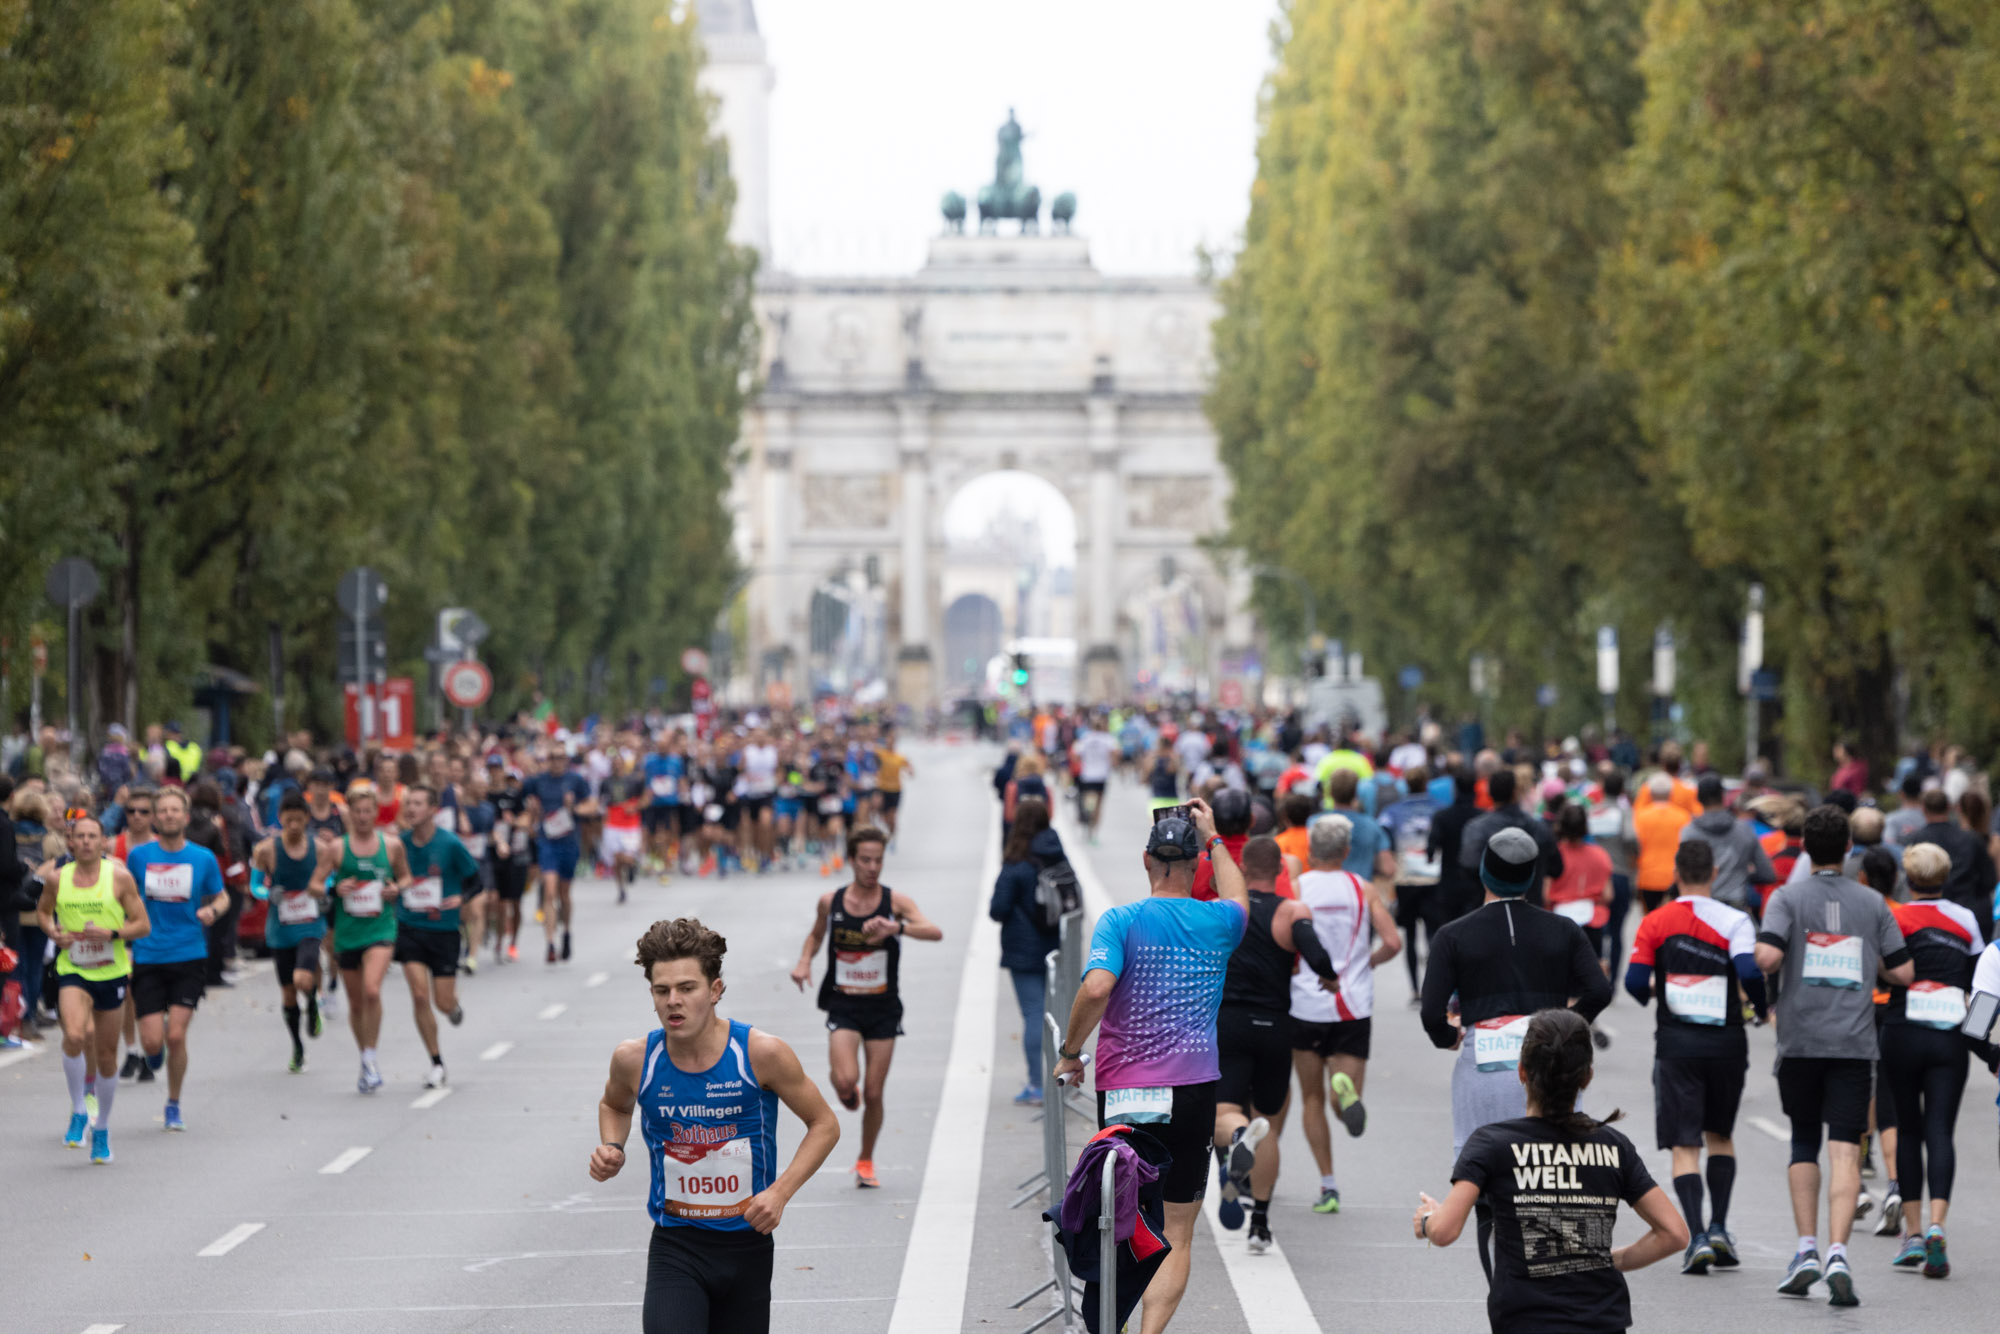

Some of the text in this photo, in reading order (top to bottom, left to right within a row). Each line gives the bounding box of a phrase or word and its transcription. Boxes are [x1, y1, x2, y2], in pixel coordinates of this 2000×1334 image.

[355, 694, 401, 738] 11
[1805, 953, 1861, 971] STAFFEL
[1668, 991, 1725, 1009] STAFFEL
[1477, 1035, 1523, 1051] STAFF
[1107, 1088, 1170, 1106] STAFFEL
[658, 1104, 742, 1118] TV Villingen
[670, 1122, 737, 1145] Rothaus
[1511, 1143, 1619, 1168] VITAMIN
[678, 1175, 739, 1194] 10500
[1513, 1166, 1582, 1190] WELL
[1513, 1194, 1557, 1204] MÜNCHEN
[1559, 1195, 1603, 1205] MARATHON
[680, 1207, 739, 1217] 10 KM-LAUF 2022
